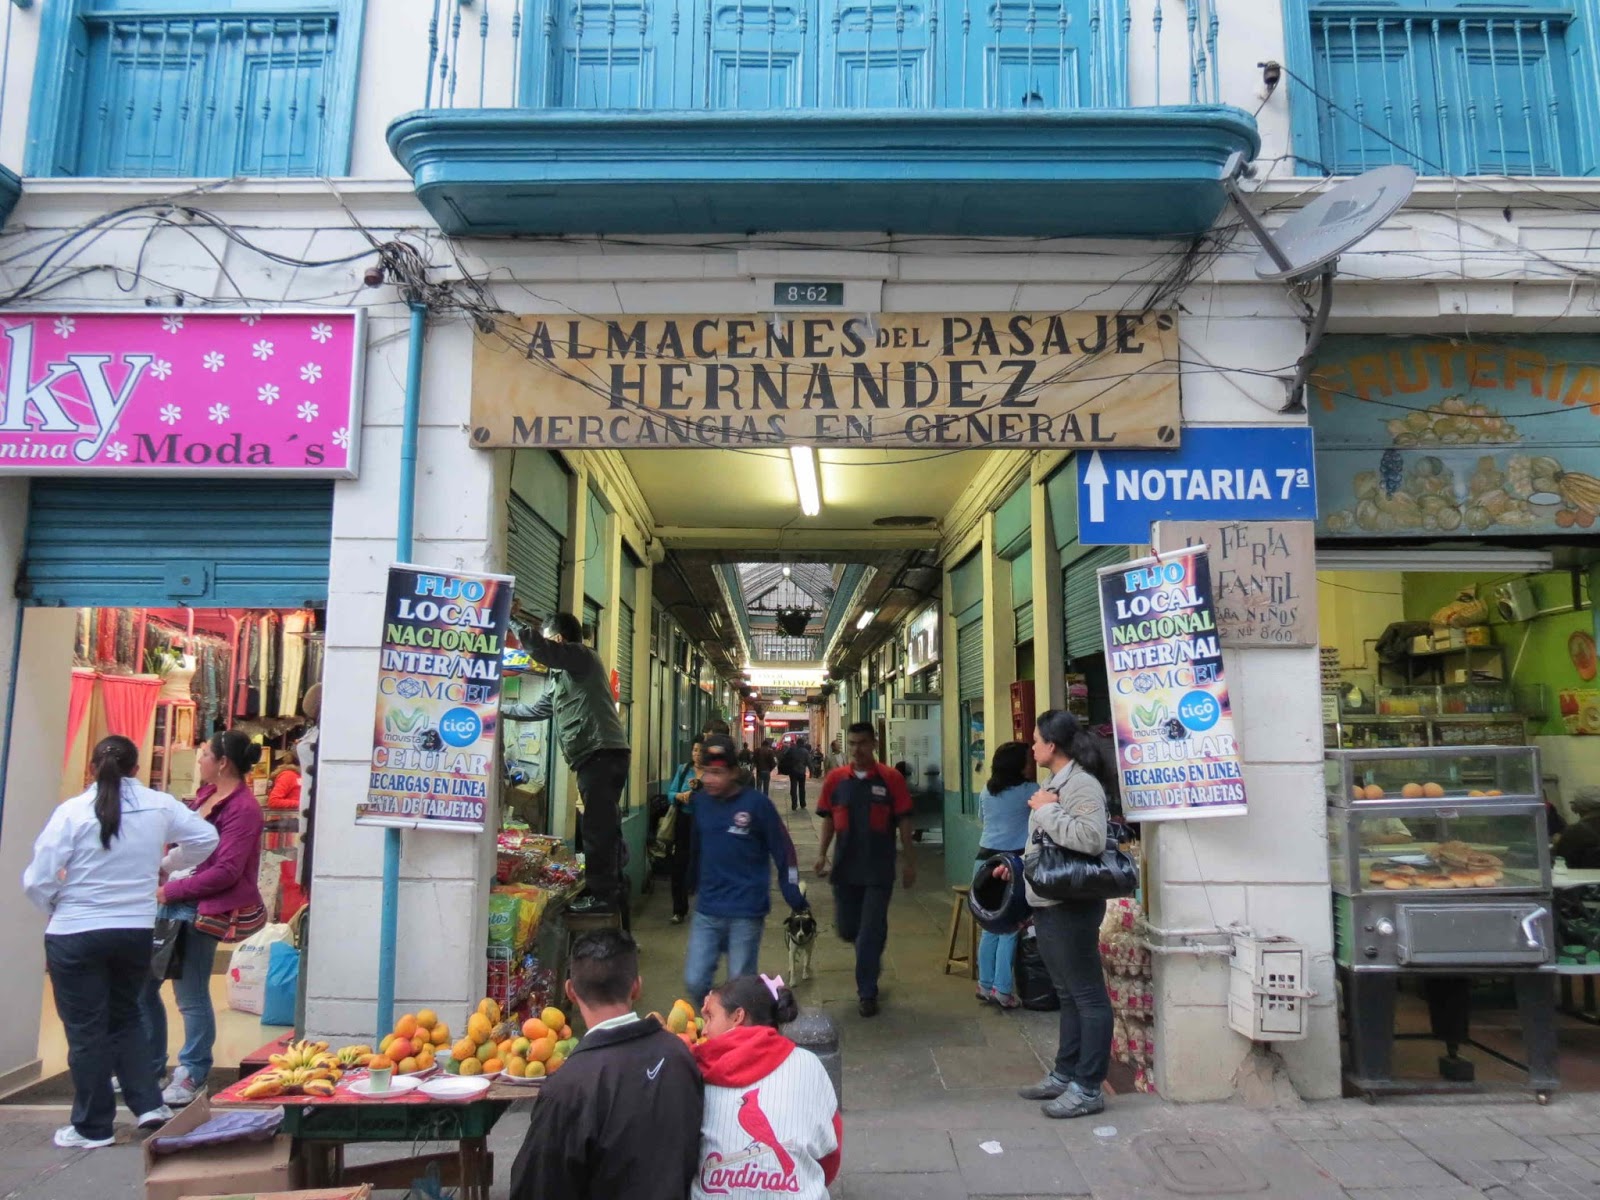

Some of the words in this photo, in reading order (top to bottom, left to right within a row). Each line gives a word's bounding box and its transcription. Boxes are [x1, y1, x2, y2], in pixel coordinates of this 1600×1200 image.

[788, 286, 827, 302] 8-62
[524, 318, 868, 360] ALMACENES
[875, 327, 930, 348] DEL
[940, 314, 1145, 356] PASAJE
[607, 360, 1040, 410] HERNANDEZ
[512, 415, 787, 444] MERCANCIAS
[815, 415, 874, 443] EN
[905, 413, 1117, 443] GENERAL
[1115, 469, 1271, 500] NOTARIA
[1218, 524, 1291, 570] FERIA
[415, 574, 486, 602] FIJO
[1124, 562, 1185, 593] FIJO
[397, 599, 496, 629] LOCAL
[1116, 585, 1203, 620] LOCAL
[386, 623, 500, 655] NACIONAL
[1112, 610, 1215, 646] NACIONAL
[381, 649, 499, 681] INTER/NAL
[1112, 636, 1220, 672] INTER/NAL
[373, 746, 488, 776] CELULAR
[1124, 734, 1236, 765] CELULAR
[433, 778, 452, 795] EN
[452, 780, 486, 797] LINEA
[1124, 765, 1186, 786] RECARGAS
[1188, 764, 1205, 781] EN
[1208, 761, 1241, 780] LINEA
[402, 797, 421, 815] DE
[422, 799, 483, 819] TARJETAS
[1126, 789, 1164, 807] VENTA
[1165, 787, 1182, 805] DE
[1184, 783, 1244, 804] TARJETAS
[701, 1151, 799, 1194] Cardinals
